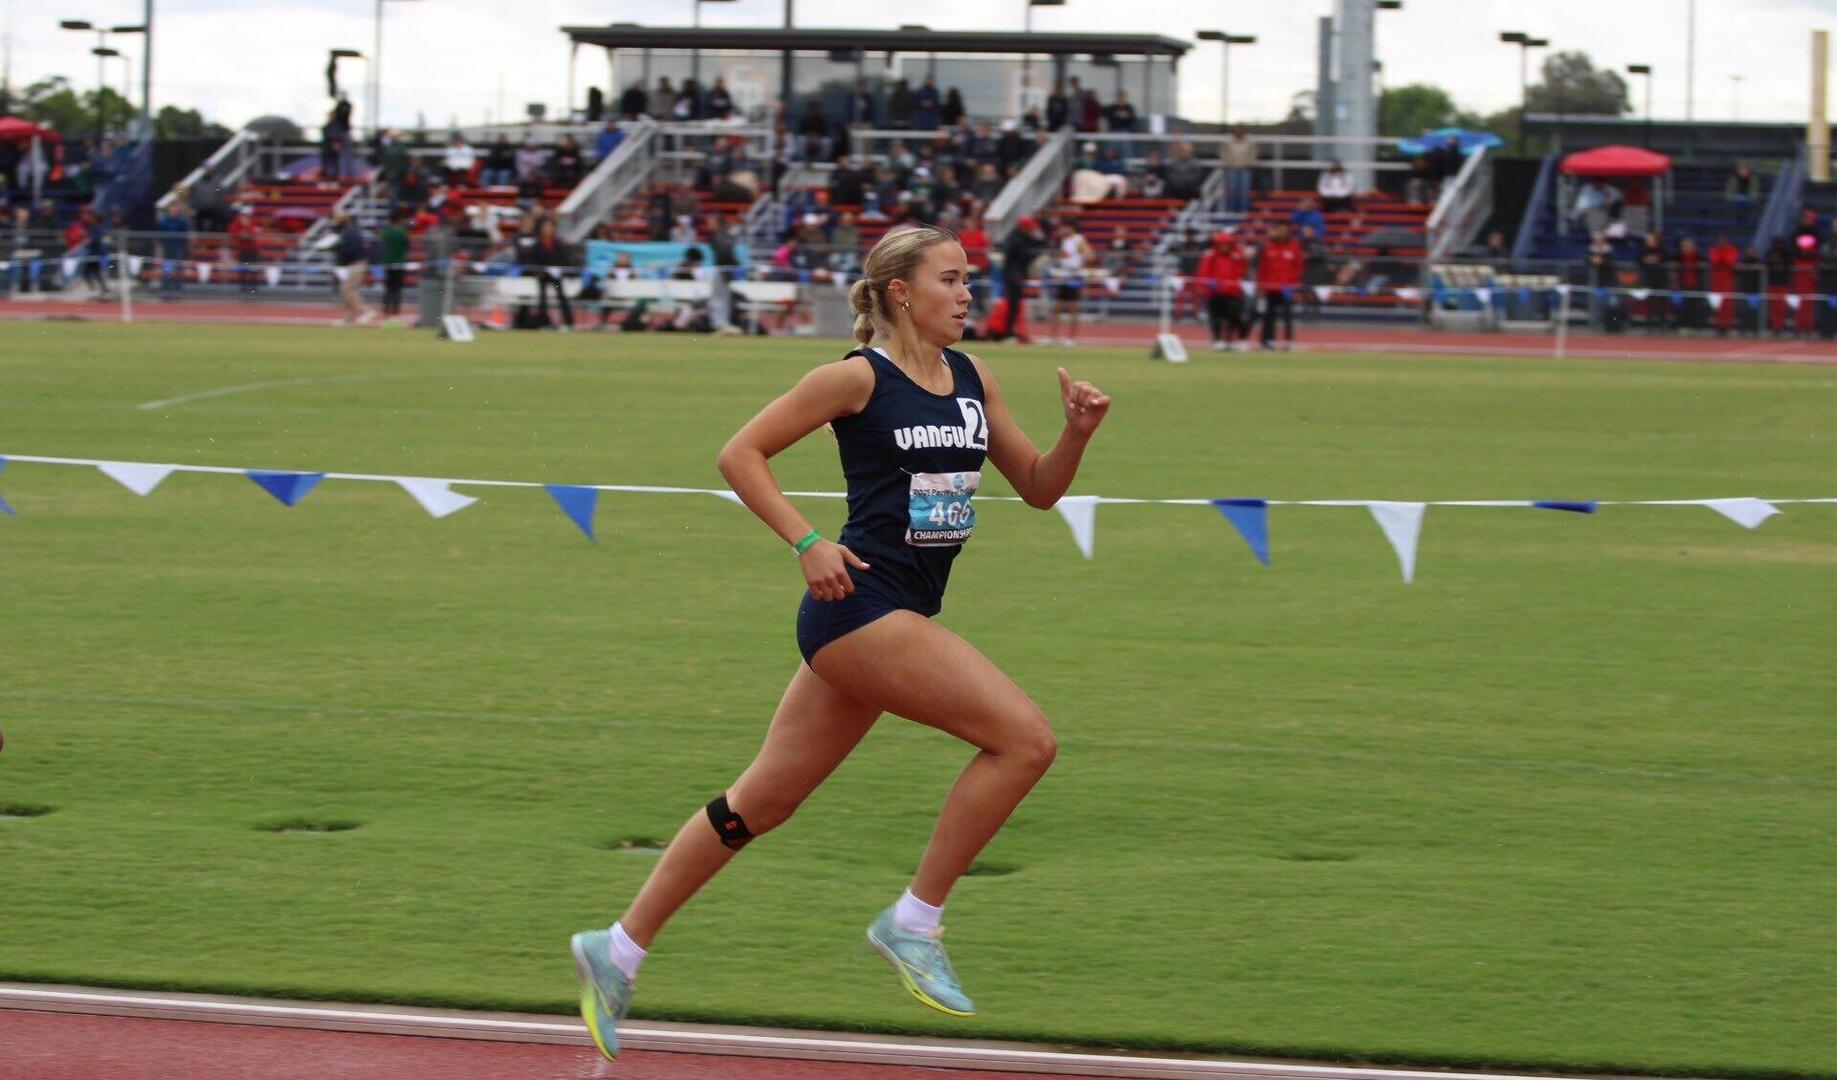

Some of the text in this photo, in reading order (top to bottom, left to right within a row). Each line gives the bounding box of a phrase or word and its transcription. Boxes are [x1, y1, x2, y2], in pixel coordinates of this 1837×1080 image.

[893, 424, 983, 451] VANGU
[964, 400, 986, 446] 2
[928, 499, 971, 528] 466
